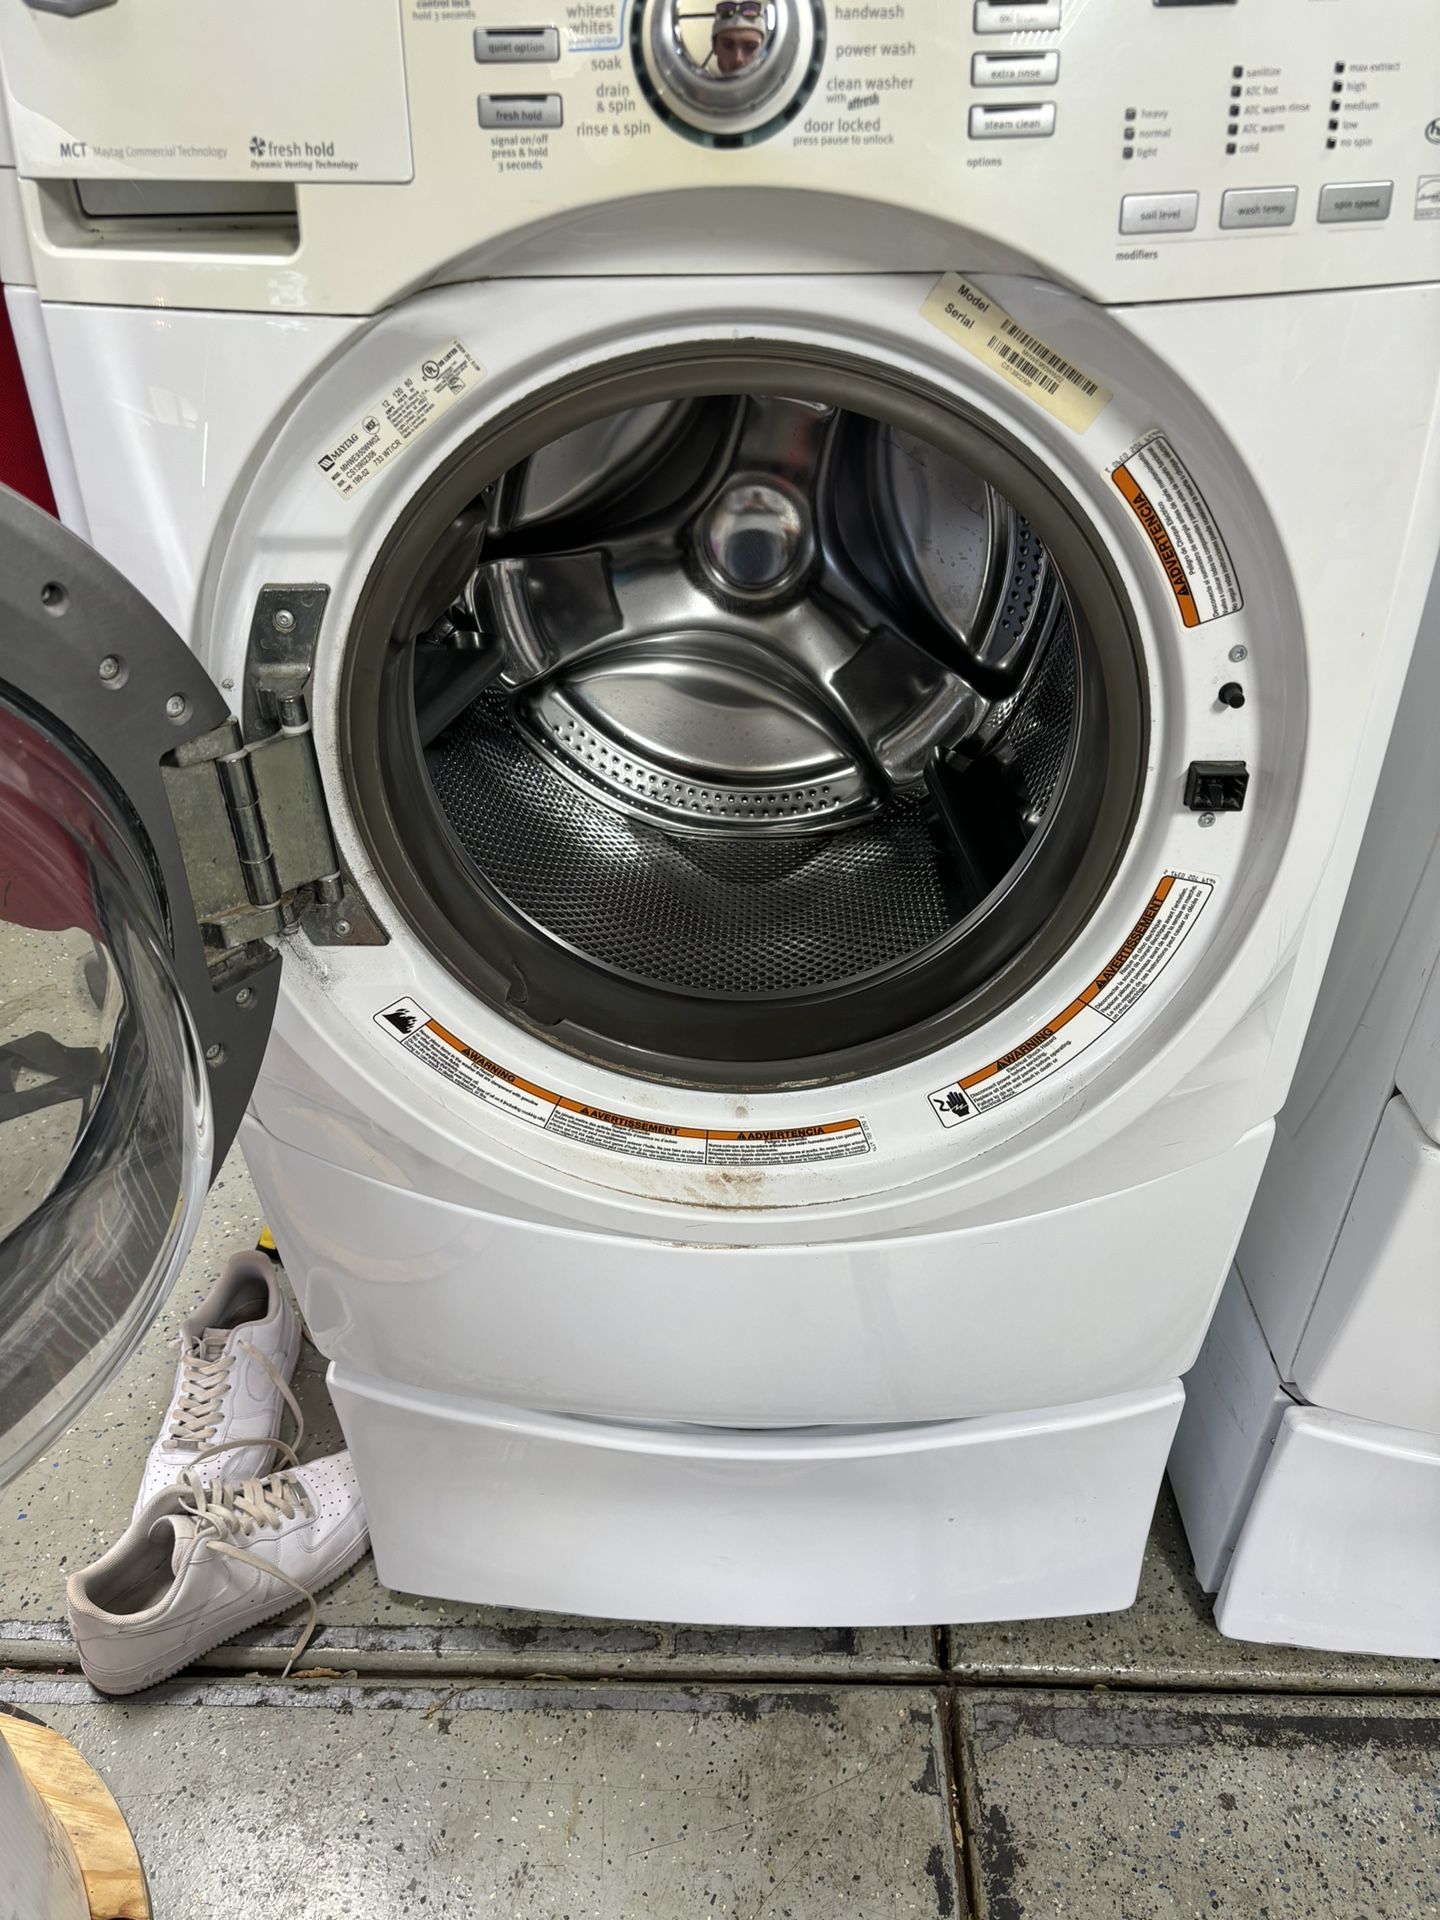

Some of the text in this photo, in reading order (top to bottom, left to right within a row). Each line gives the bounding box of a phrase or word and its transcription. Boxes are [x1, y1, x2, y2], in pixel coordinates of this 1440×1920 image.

[413, 10, 476, 22] hold 3 seconds
[566, 3, 614, 18] whitest
[835, 6, 904, 20] handwash
[570, 20, 613, 34] whites
[488, 43, 544, 54] quiet option
[836, 42, 916, 60] power wash
[591, 57, 622, 71] soak
[991, 68, 1040, 80] extra rinse
[1246, 66, 1281, 78] sanitize
[827, 77, 914, 92] clean washer
[1347, 82, 1366, 92] high
[596, 84, 629, 99] drain
[826, 94, 846, 104] with
[596, 100, 636, 116] & spin
[1344, 101, 1380, 112] medium
[496, 110, 542, 122] fresh hold
[1141, 109, 1168, 120] heavy
[576, 122, 650, 138] rinse & spin
[804, 117, 880, 134] door locked
[985, 118, 1040, 130] steam clean
[1343, 120, 1358, 130] low
[1139, 128, 1171, 138] normal
[490, 134, 548, 147] signal on/off
[793, 133, 894, 148] press pause to unlock
[60, 142, 228, 160] MCT Maytag Commercial Technology
[268, 142, 335, 157] fresh hold
[492, 147, 548, 159] press & hold
[1136, 147, 1158, 158] light
[1240, 142, 1259, 154] cold
[250, 160, 358, 170] Dynamic Venting Technology
[498, 160, 543, 172] 3 seconds
[966, 156, 1002, 169] options
[1237, 204, 1285, 217] wash temp
[1334, 198, 1380, 210] spin speed
[1140, 210, 1180, 221] soil level
[1116, 249, 1158, 262] modifiers
[956, 283, 990, 313] Model
[943, 301, 975, 330] Serial
[364, 419, 377, 431] NSF
[330, 433, 359, 460] MAYTAG
[373, 455, 383, 465] 733
[382, 439, 401, 457] WT/CR
[1133, 493, 1186, 582] ADVERTENCIA
[1103, 896, 1163, 980] AVERTISSEMENT
[1005, 1028, 1053, 1064] WARNING
[470, 1051, 515, 1083] WARNING
[591, 1110, 678, 1134] AVERTISSEMENT
[749, 1127, 823, 1138] ADVERTENCIA
